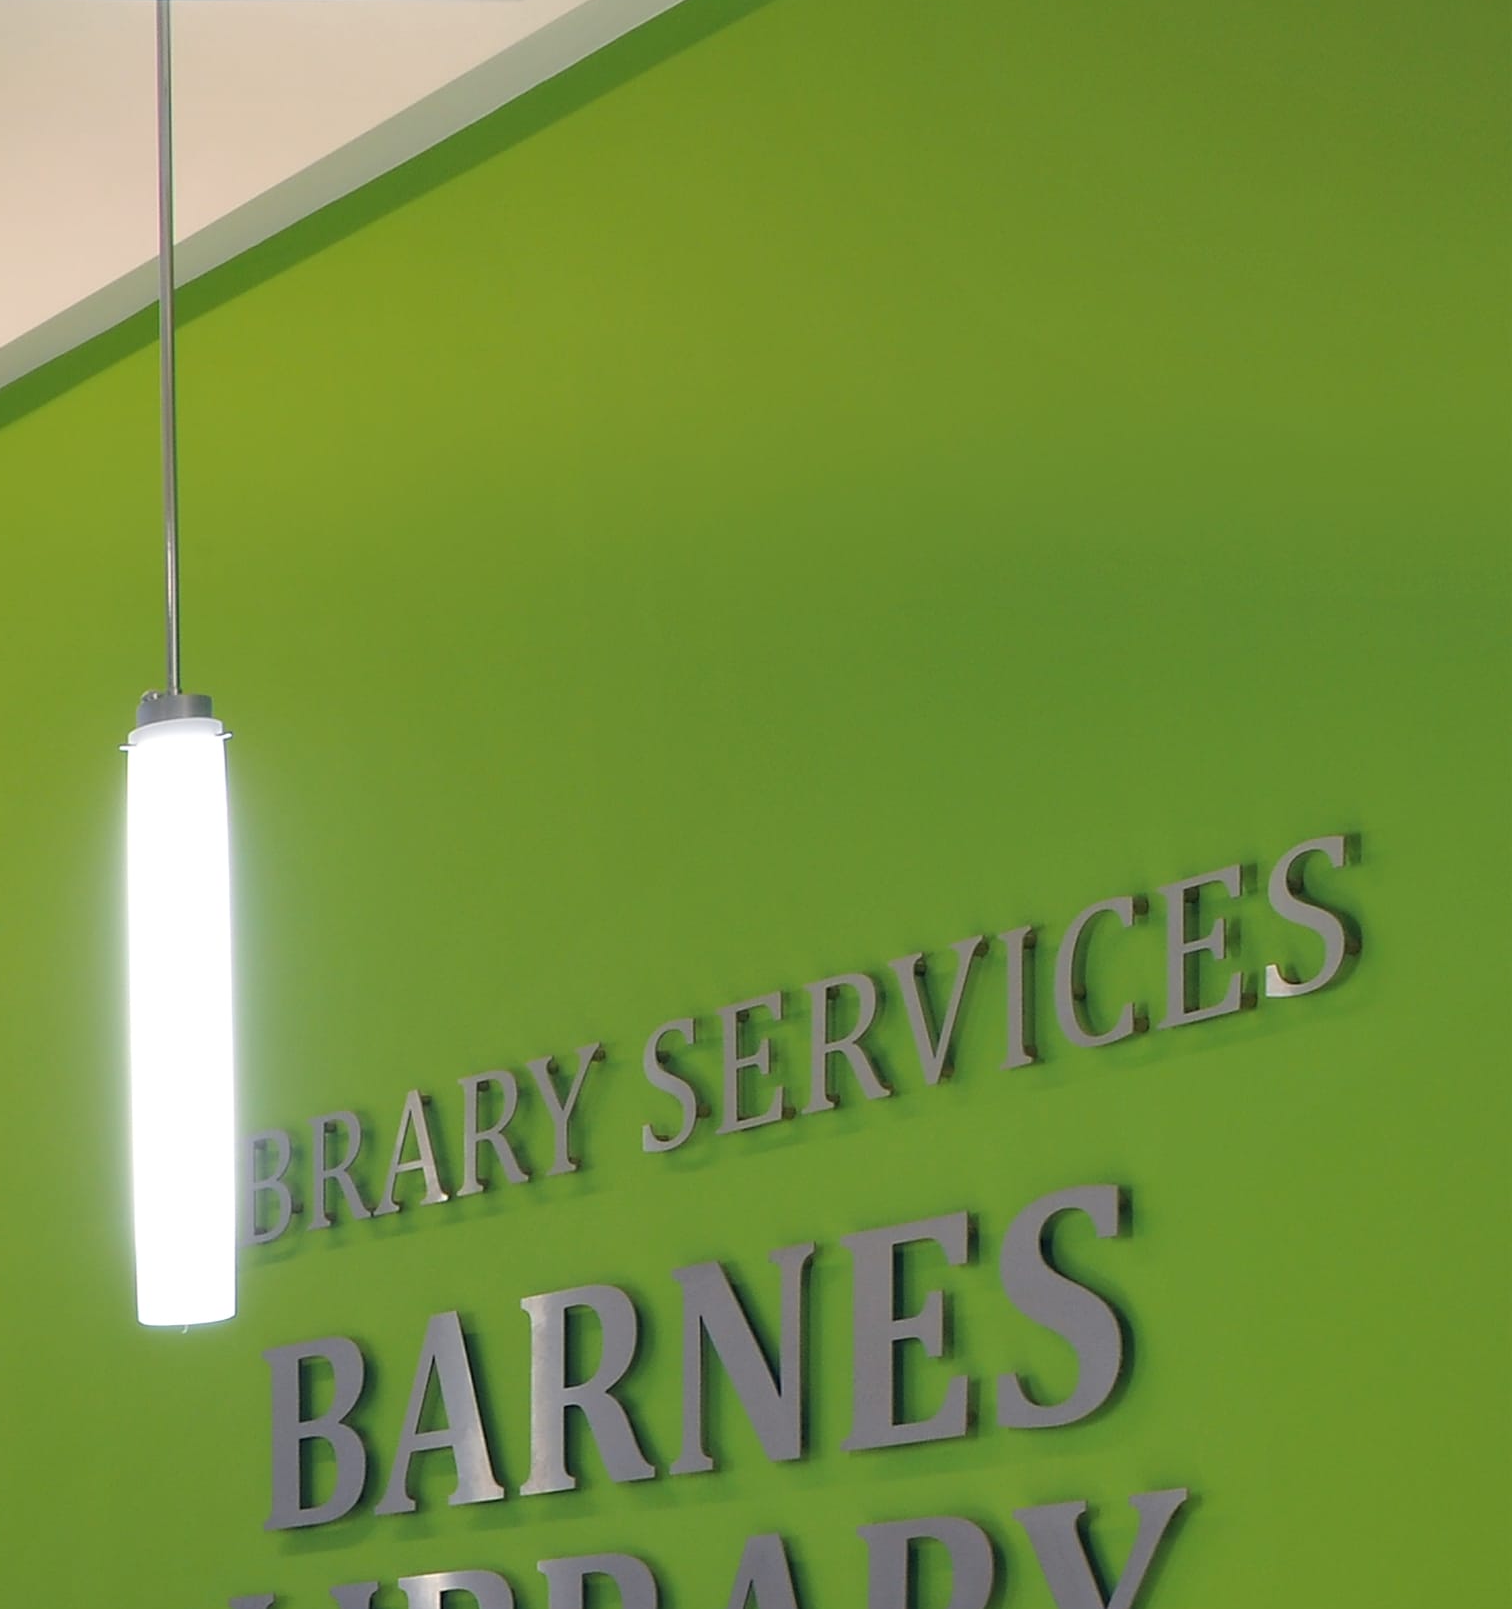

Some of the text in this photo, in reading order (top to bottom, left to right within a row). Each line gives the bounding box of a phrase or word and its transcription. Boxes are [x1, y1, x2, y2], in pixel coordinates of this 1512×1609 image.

[241, 832, 1360, 1249] BRARY SERVICES
[264, 1182, 1132, 1533] BARNES
